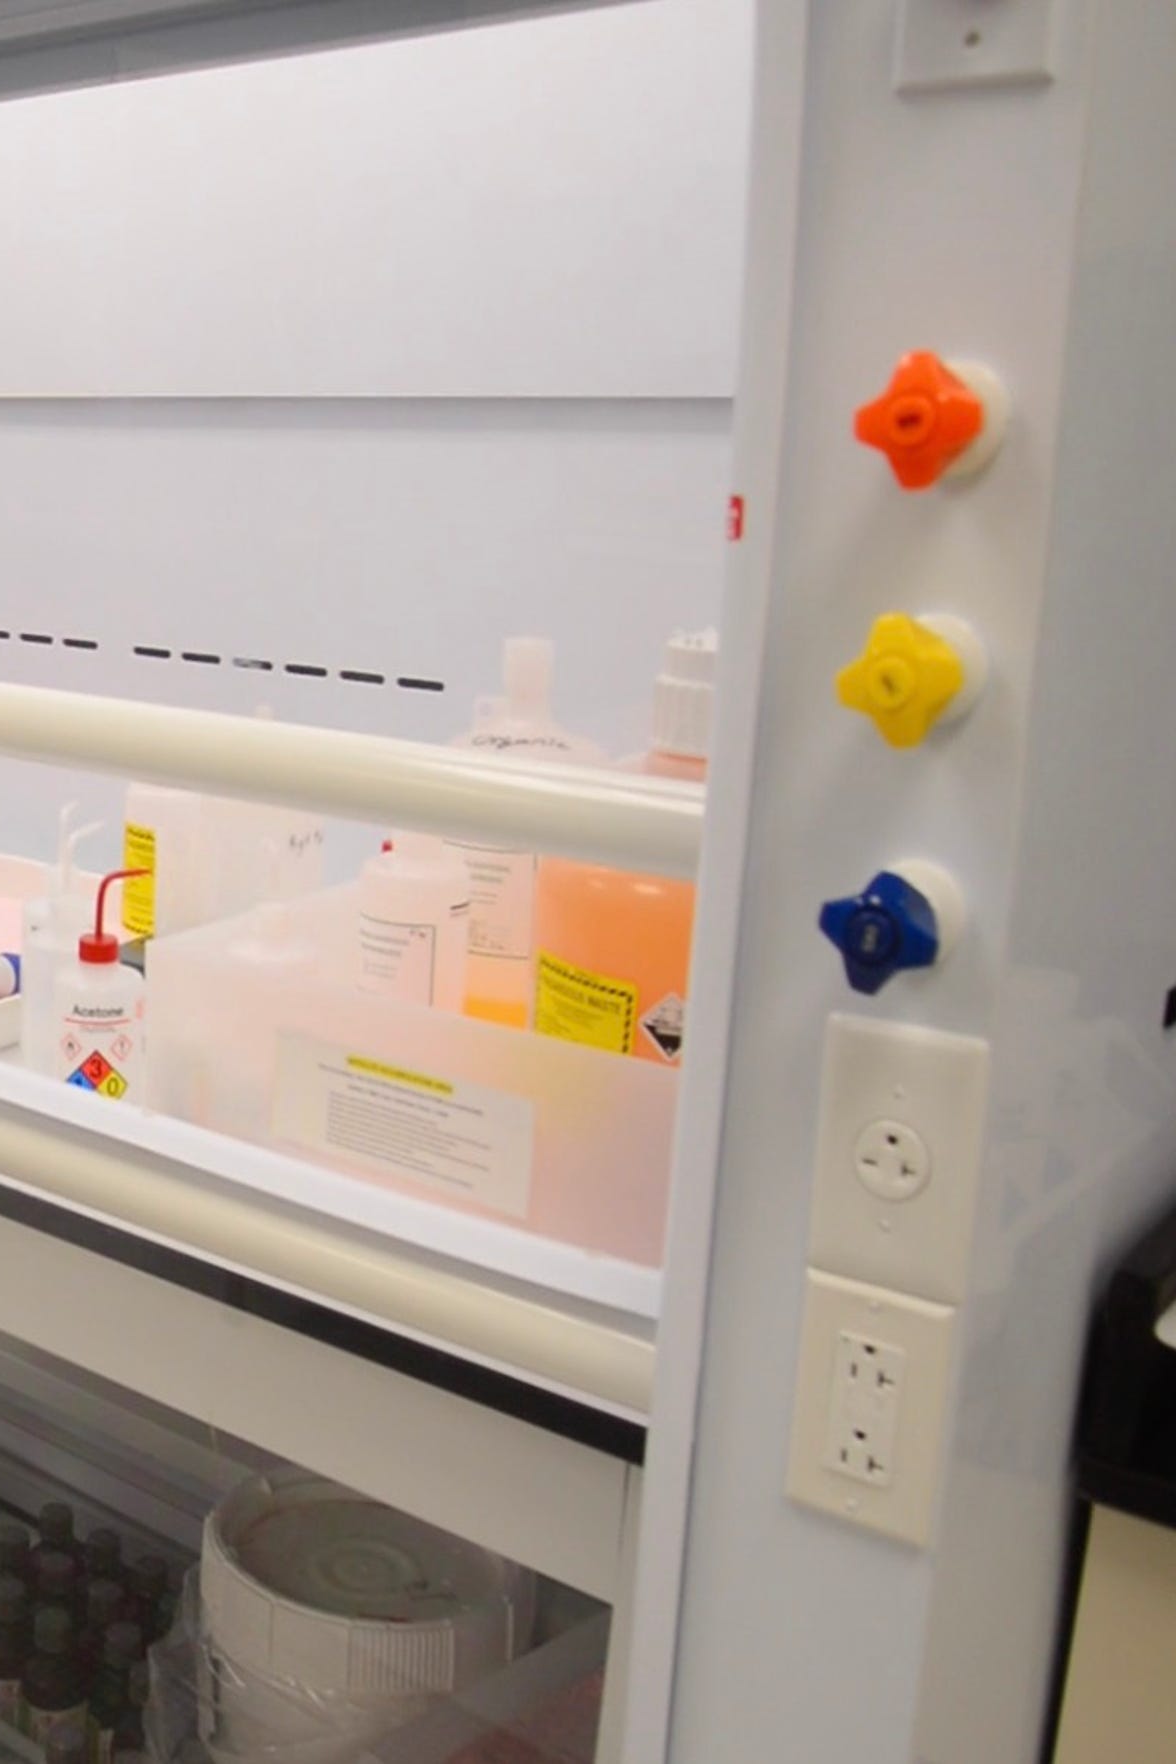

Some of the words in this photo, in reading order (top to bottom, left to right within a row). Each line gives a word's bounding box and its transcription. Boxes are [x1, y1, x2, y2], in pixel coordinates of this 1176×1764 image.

[73, 1005, 123, 1017] Acetone
[89, 1058, 103, 1080] 3
[106, 1076, 121, 1098] 0
